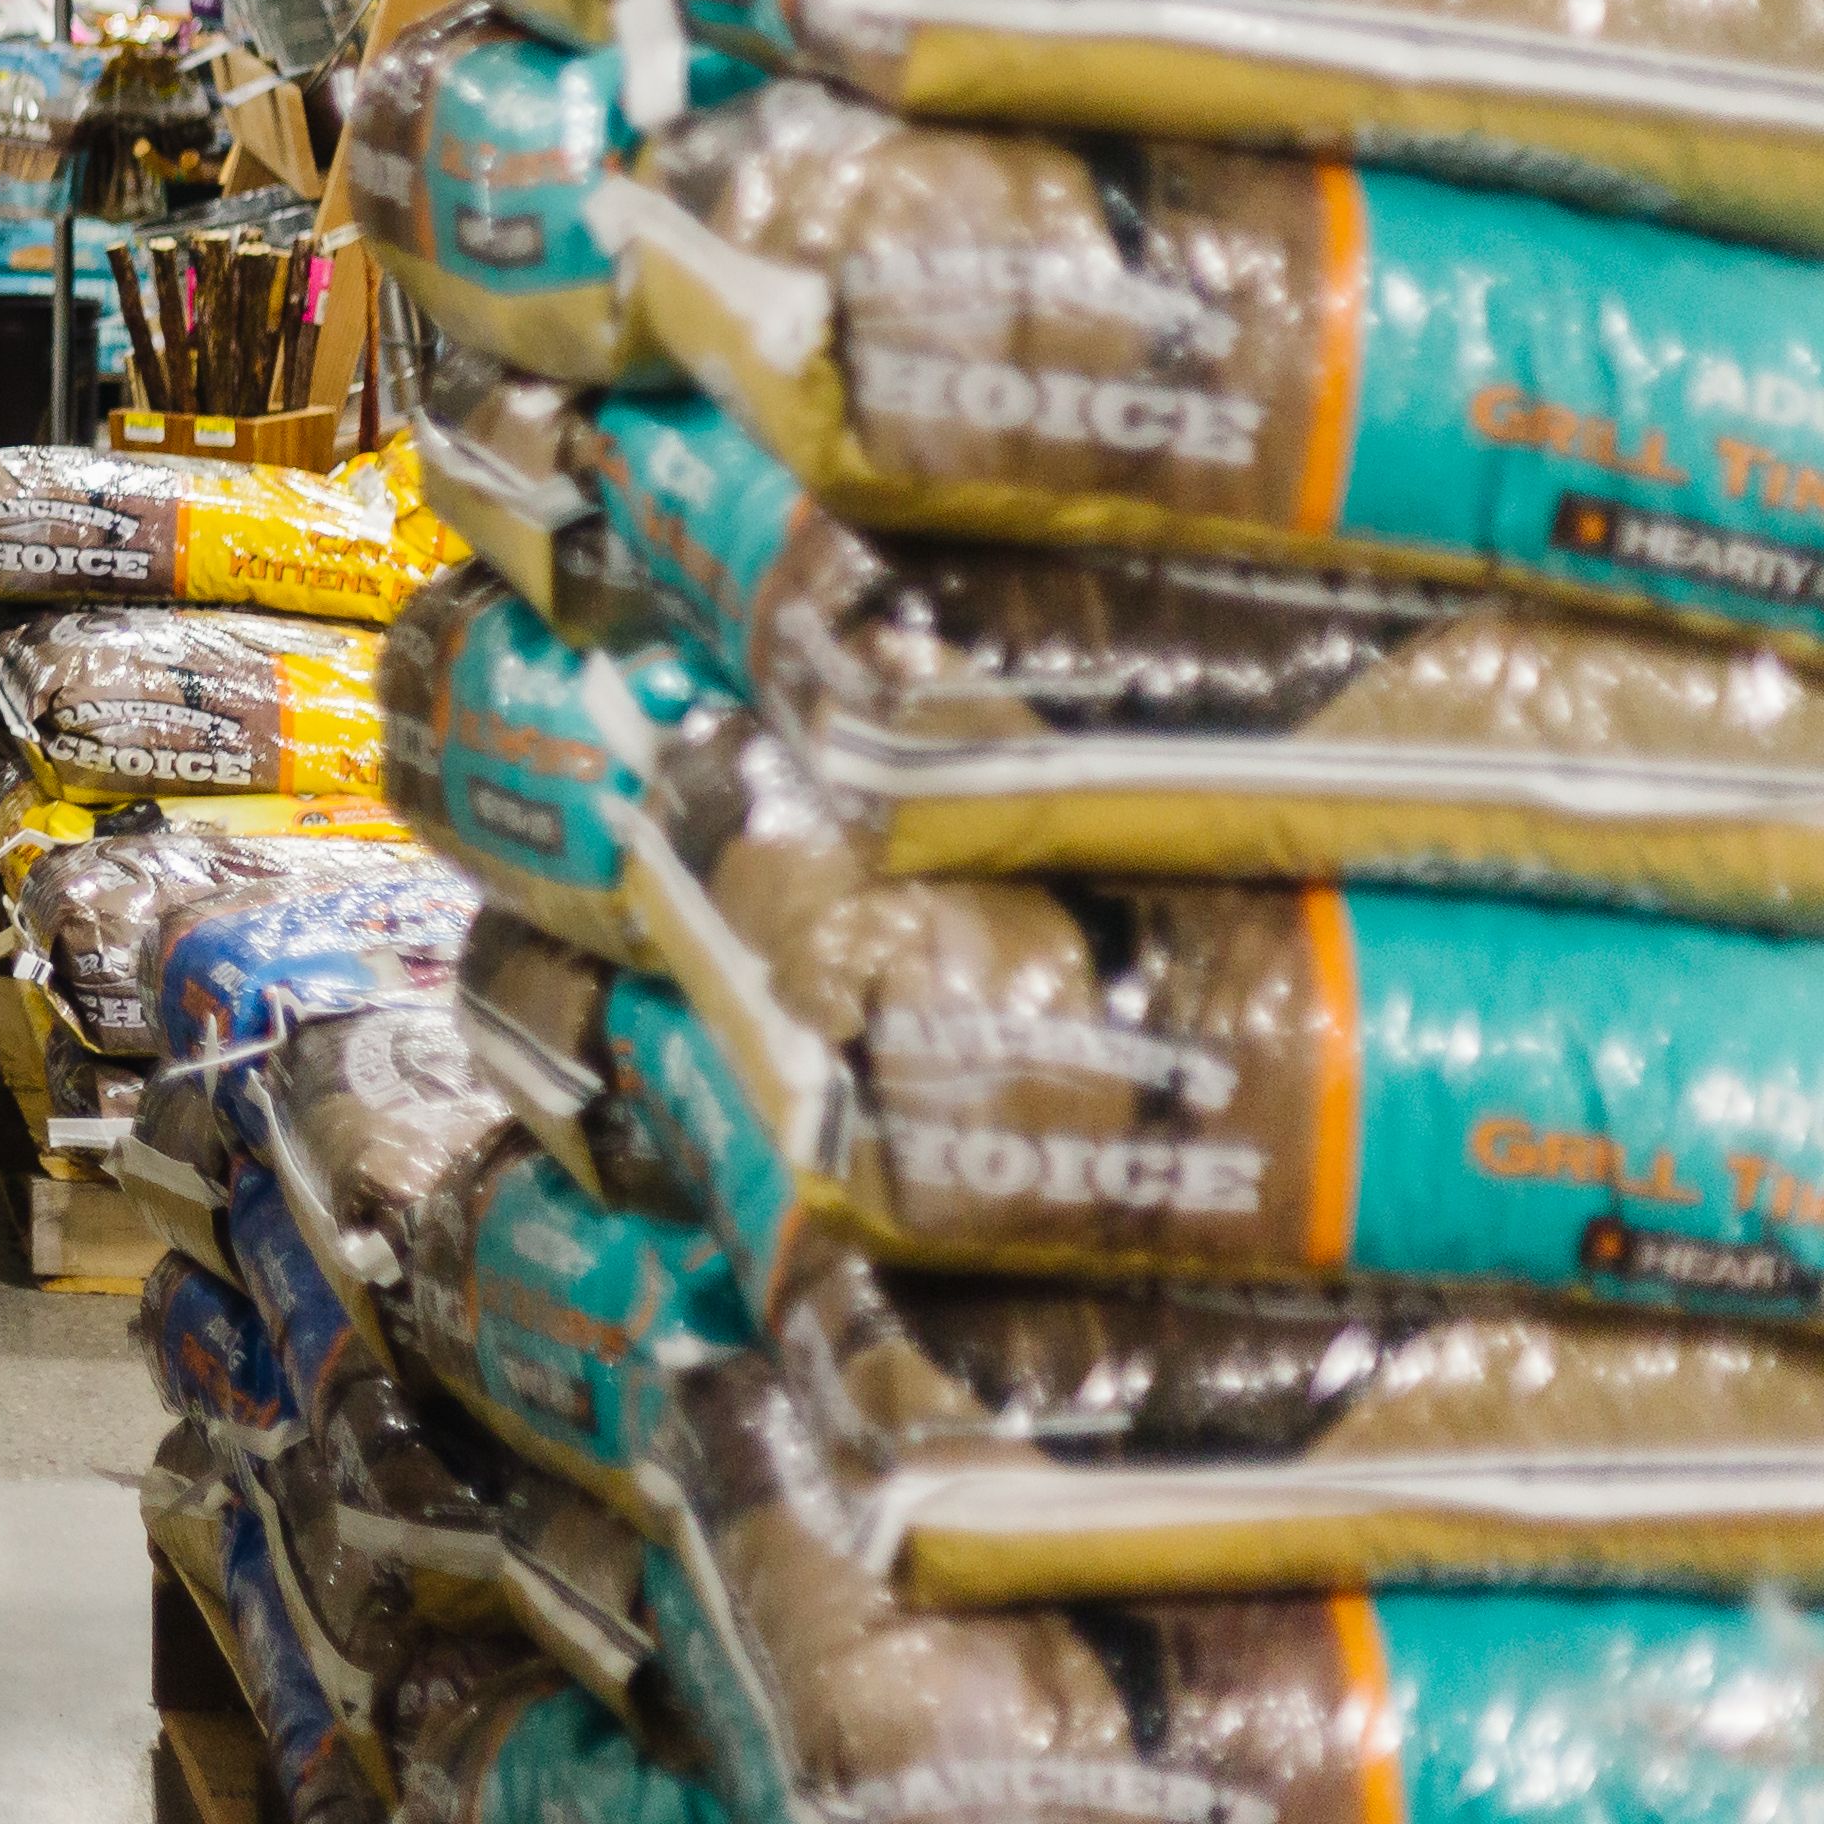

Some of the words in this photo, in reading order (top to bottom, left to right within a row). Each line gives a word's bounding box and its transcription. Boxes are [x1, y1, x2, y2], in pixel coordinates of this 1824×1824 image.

[857, 344, 1265, 467] HOICE
[1471, 380, 1690, 486] GRILL
[229, 552, 381, 597] KITTENS
[1617, 517, 1816, 598] HEARTY
[48, 733, 253, 785] CHOICE
[53, 699, 241, 740] RANCHER'S
[1471, 1117, 1703, 1207] GRILL
